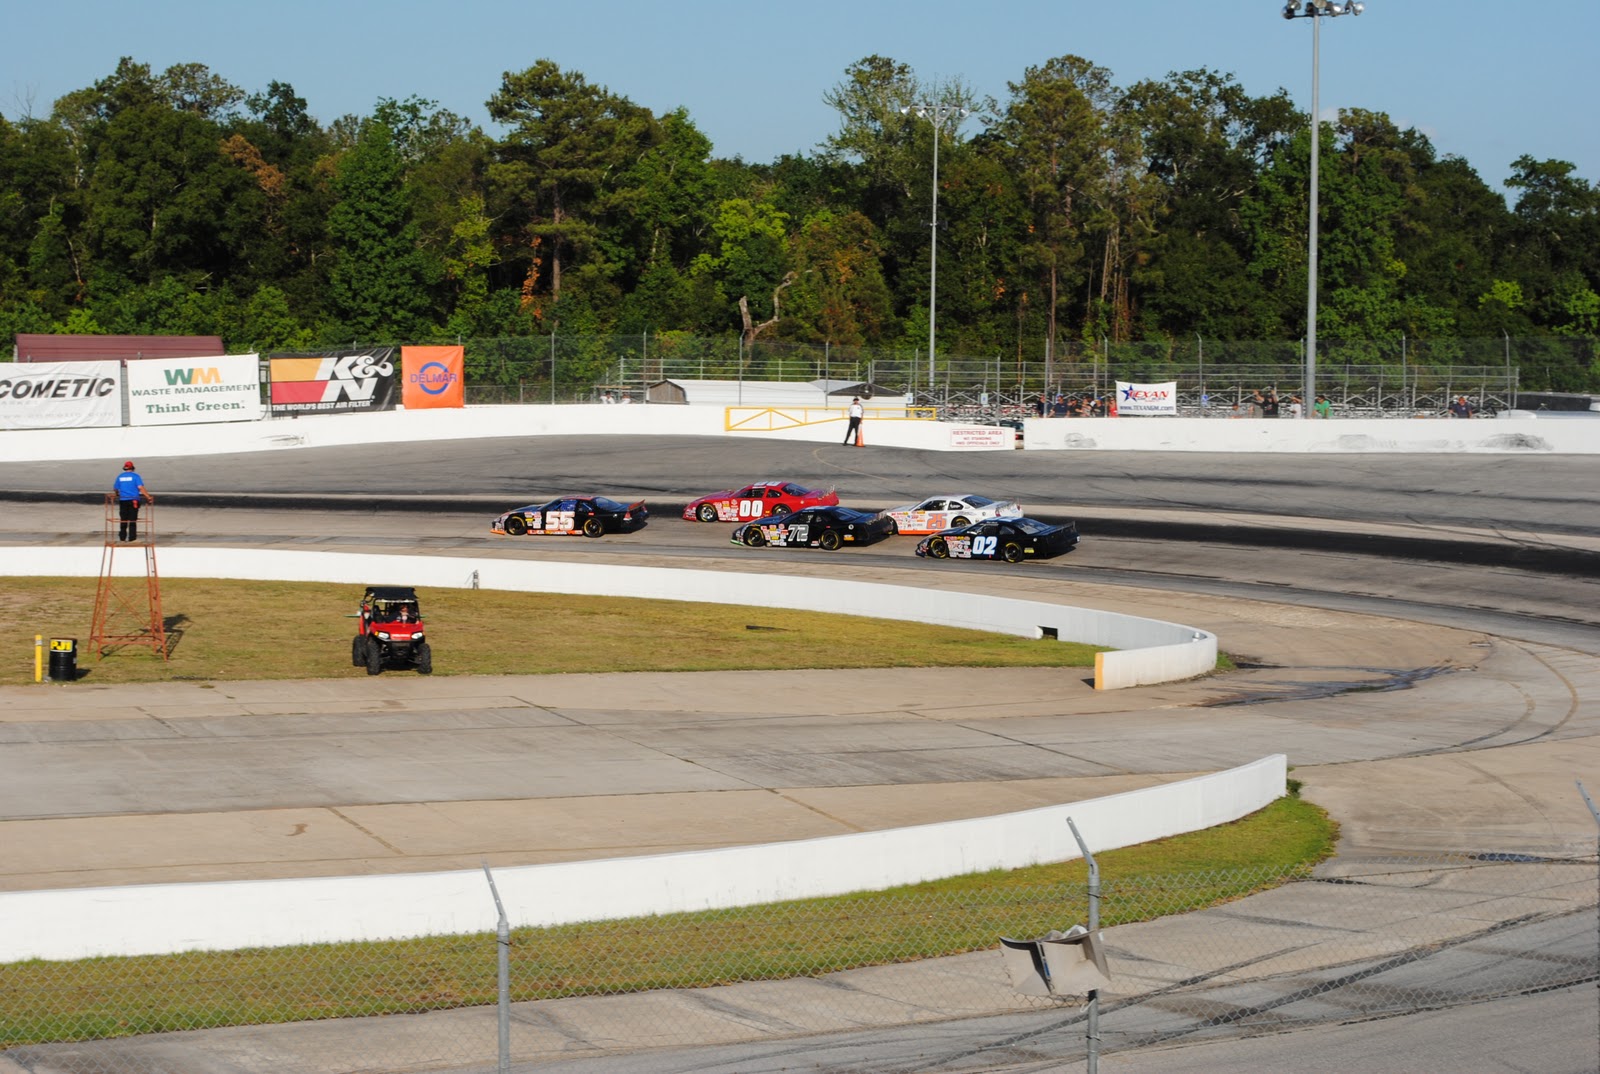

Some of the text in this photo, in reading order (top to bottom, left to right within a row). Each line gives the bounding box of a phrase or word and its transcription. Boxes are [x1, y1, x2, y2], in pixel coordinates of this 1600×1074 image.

[164, 367, 221, 386] WM
[410, 373, 457, 383] DELMAR
[0, 378, 115, 399] COMETIC
[132, 384, 257, 396] WASTE MANAGEMENT
[1129, 390, 1169, 398] TEXAN
[146, 403, 190, 413] Think
[740, 500, 763, 517] 00
[545, 511, 575, 530] 55
[926, 513, 948, 529] 25
[788, 524, 809, 542] 72
[972, 536, 998, 555] 02
